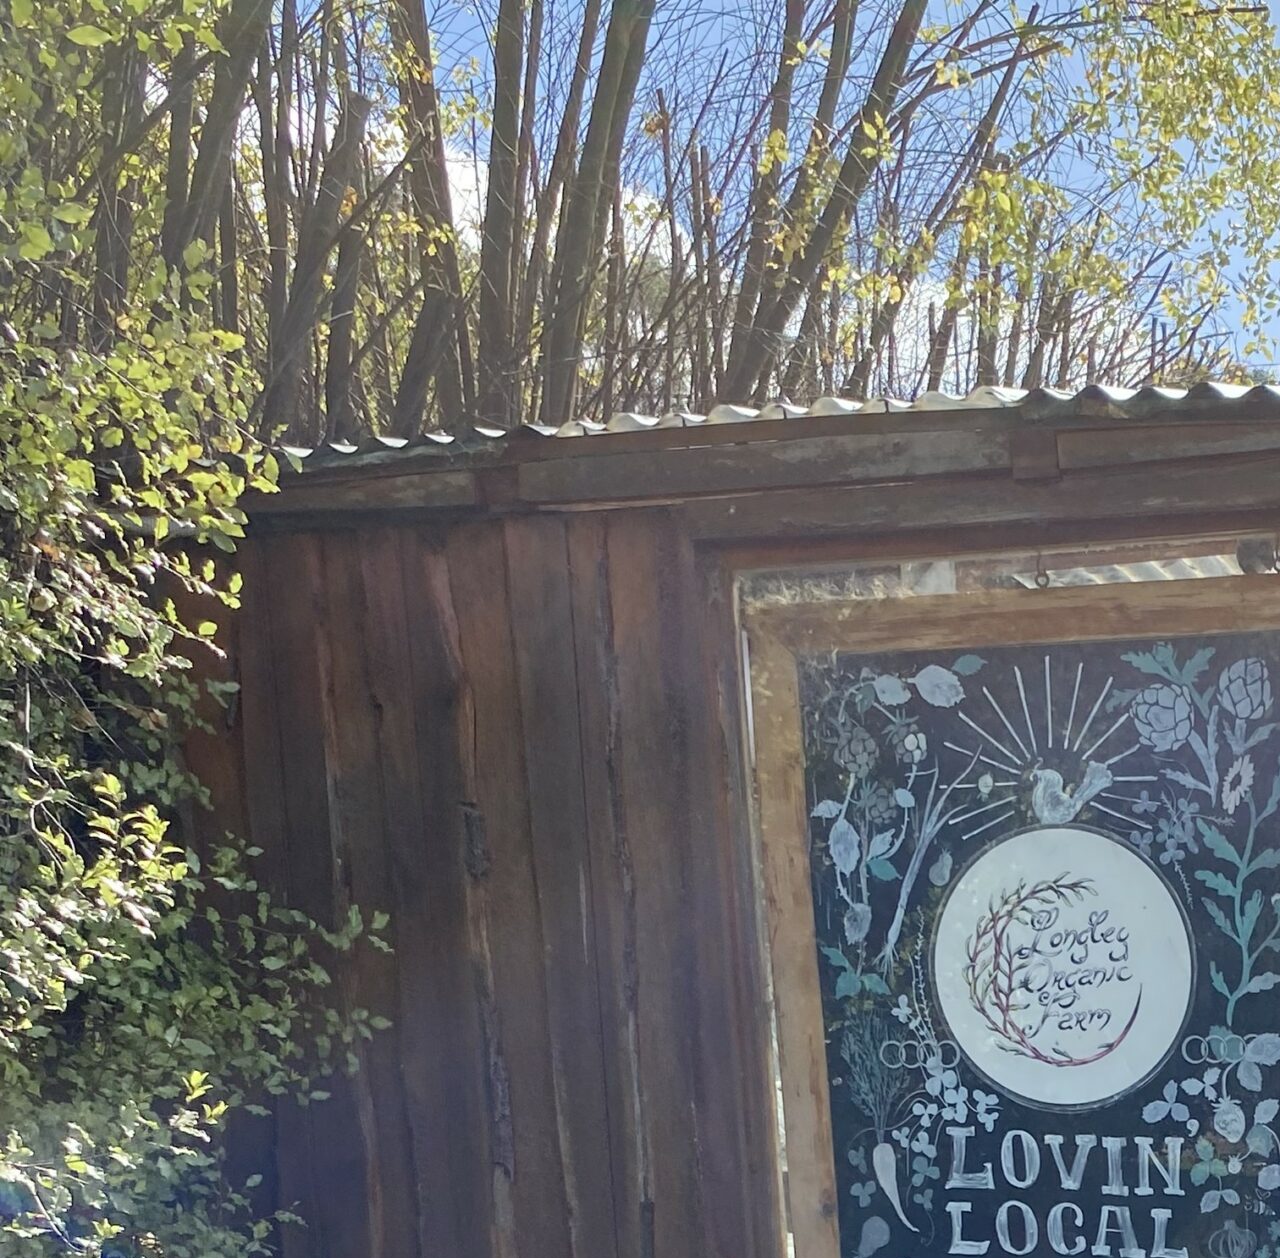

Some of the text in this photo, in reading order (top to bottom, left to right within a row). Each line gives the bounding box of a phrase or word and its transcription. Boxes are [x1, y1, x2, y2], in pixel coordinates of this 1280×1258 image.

[1016, 906, 1130, 963] Longley
[1019, 958, 1134, 1008] Organic
[1024, 990, 1112, 1038] Farm
